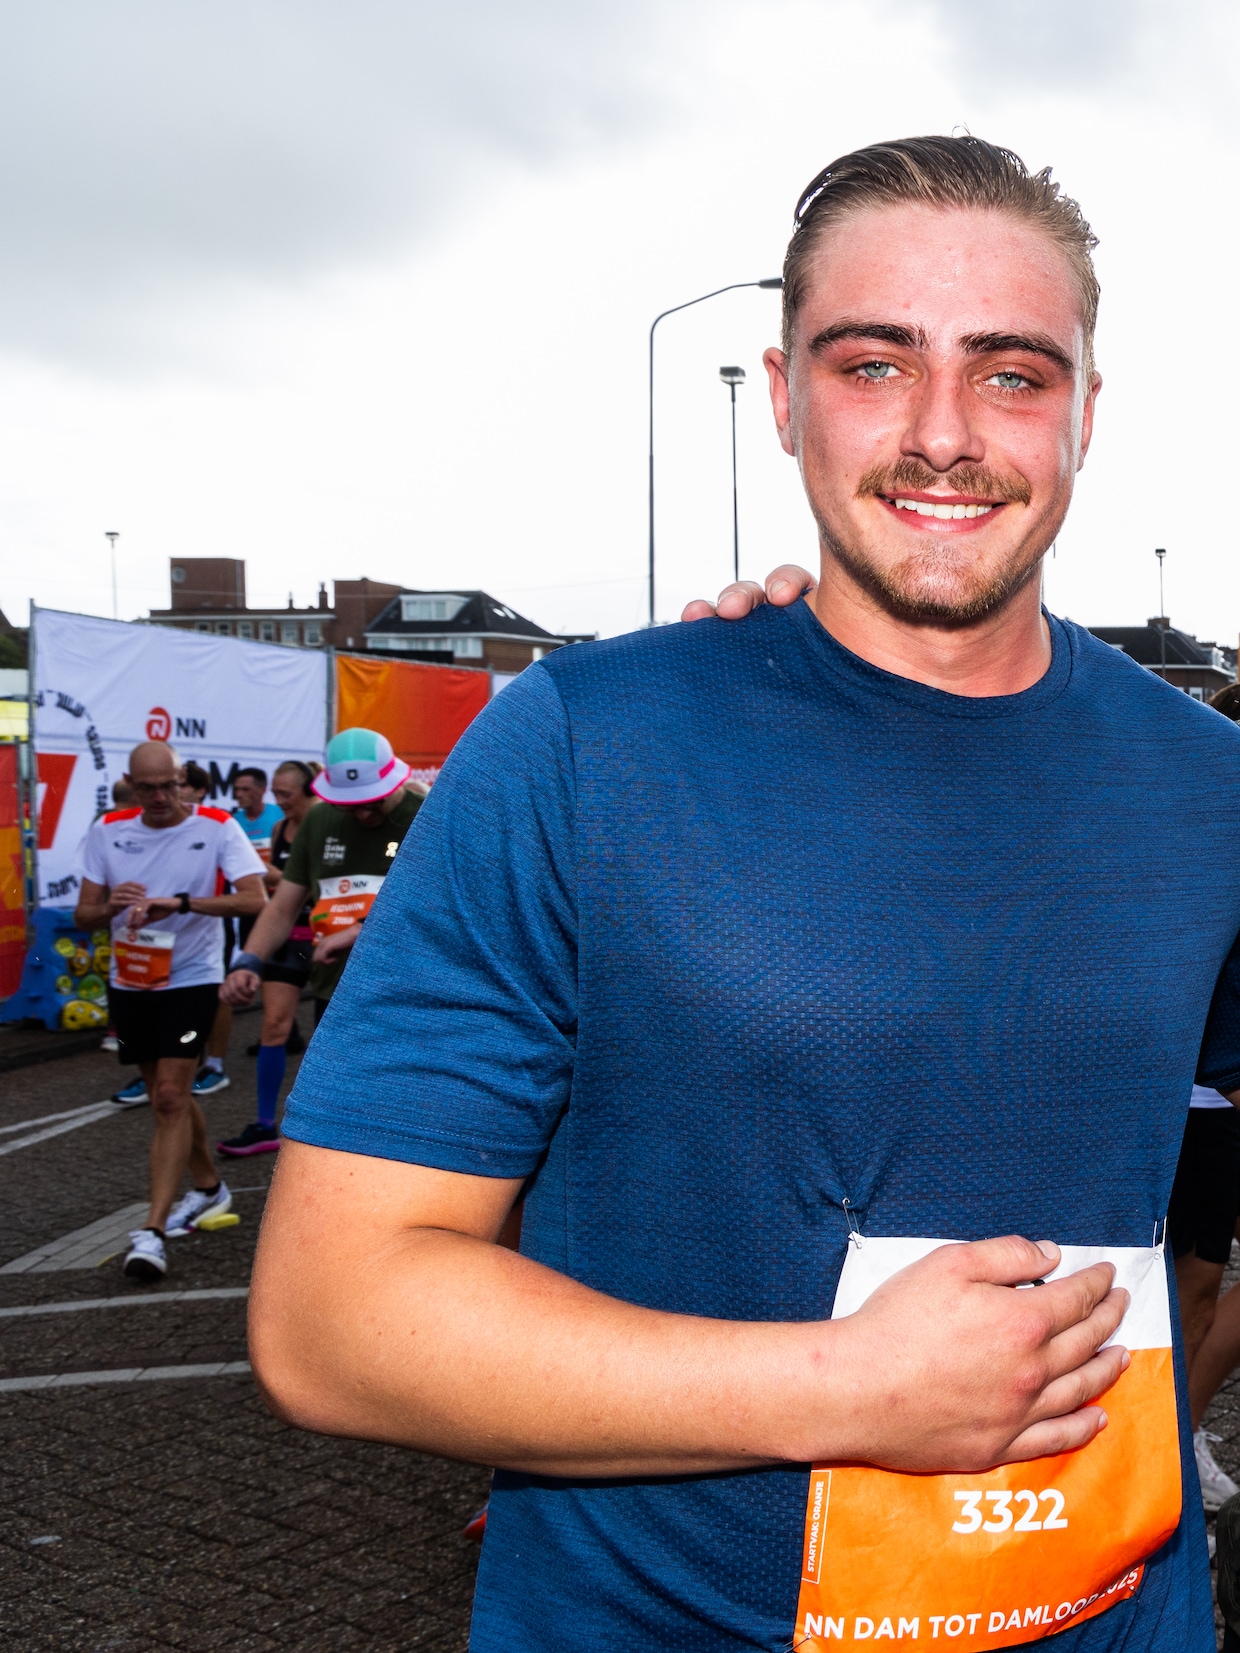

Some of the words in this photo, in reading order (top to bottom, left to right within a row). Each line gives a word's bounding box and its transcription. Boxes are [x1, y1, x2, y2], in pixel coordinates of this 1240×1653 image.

[176, 717, 206, 738] NN
[812, 1481, 824, 1521] ORANJE
[951, 1488, 1069, 1534] 3322
[807, 1521, 820, 1573] STARTVAK:
[804, 1612, 845, 1640] NN
[853, 1616, 920, 1640] DAM
[928, 1613, 982, 1638] TOT
[987, 1592, 1099, 1634] DAMLOOP
